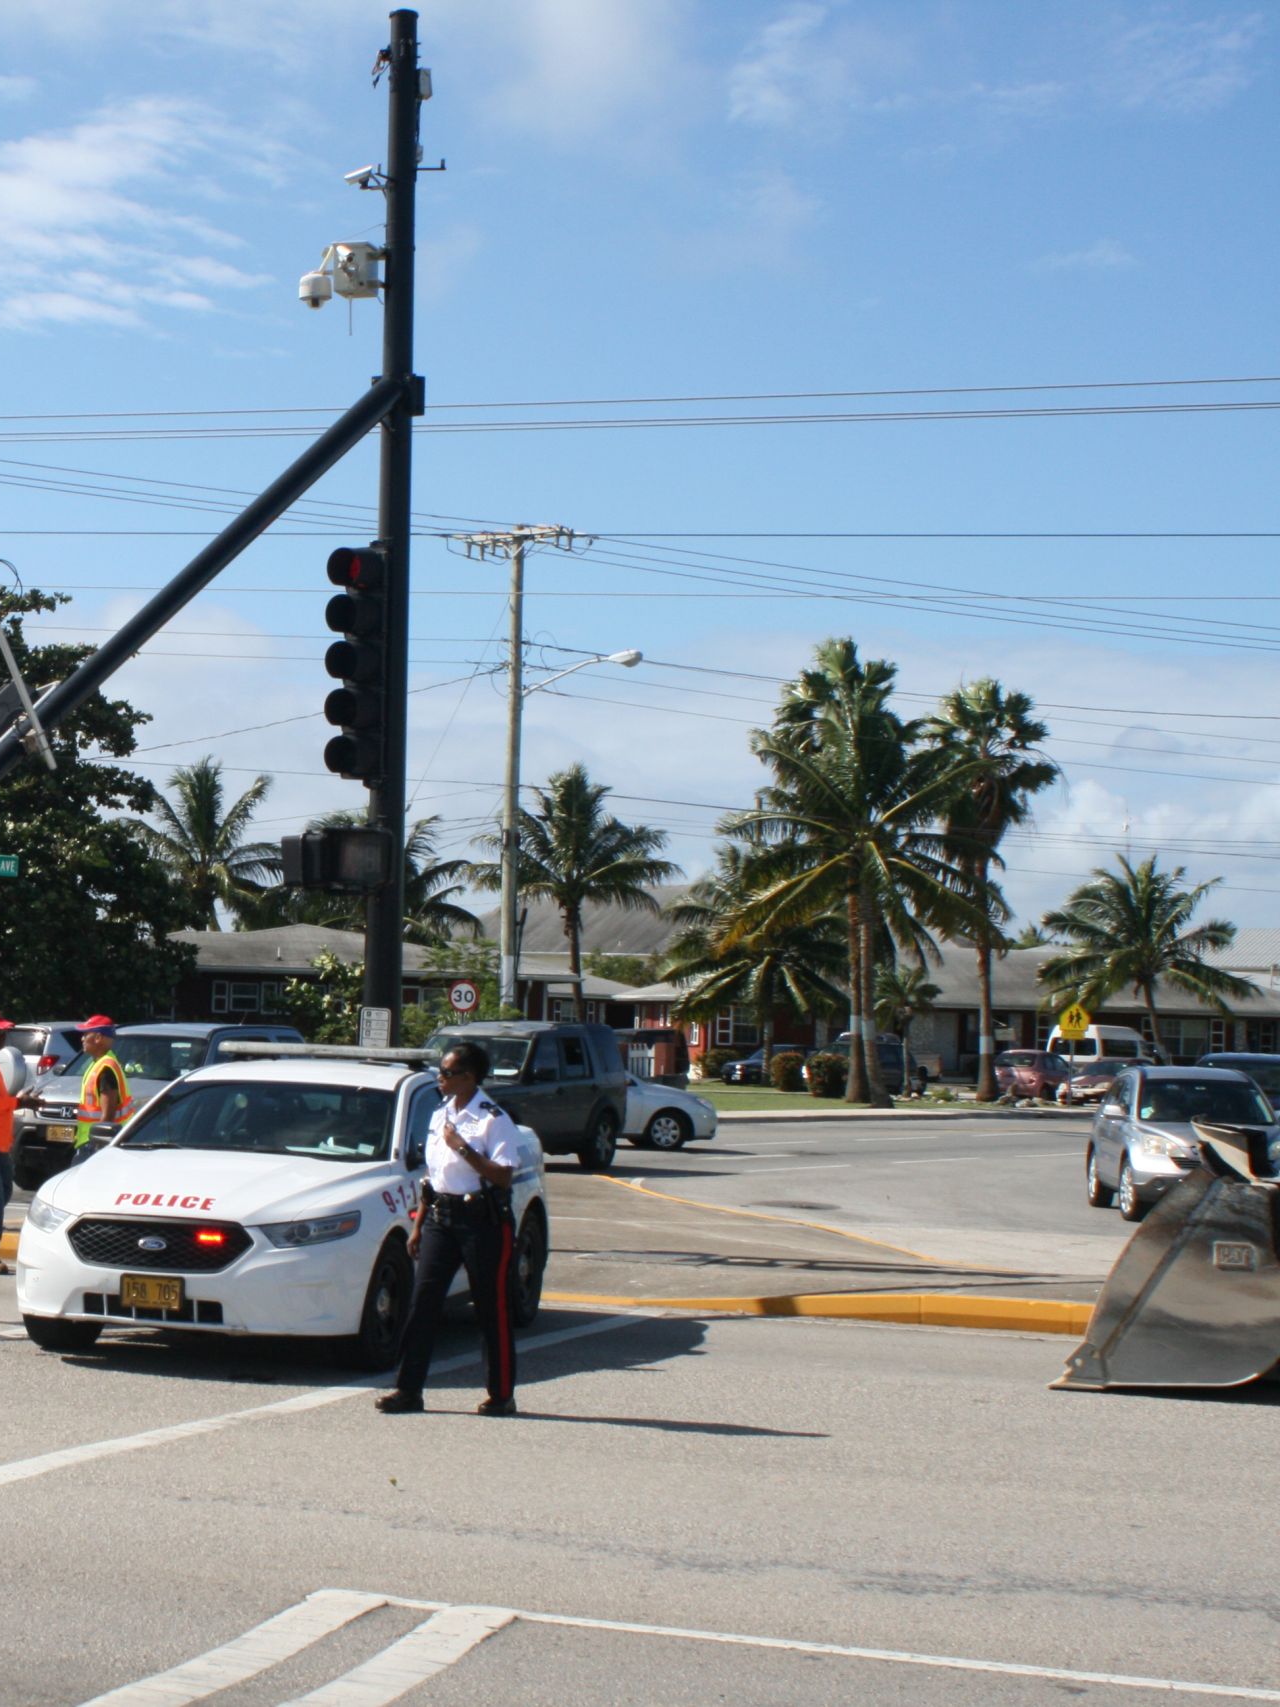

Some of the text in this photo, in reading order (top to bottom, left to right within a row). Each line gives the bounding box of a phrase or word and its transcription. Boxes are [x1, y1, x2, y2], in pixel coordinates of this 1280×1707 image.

[0, 860, 16, 873] AVE
[453, 990, 474, 1003] 30
[114, 1193, 216, 1211] POLICE
[155, 1282, 178, 1302] 705
